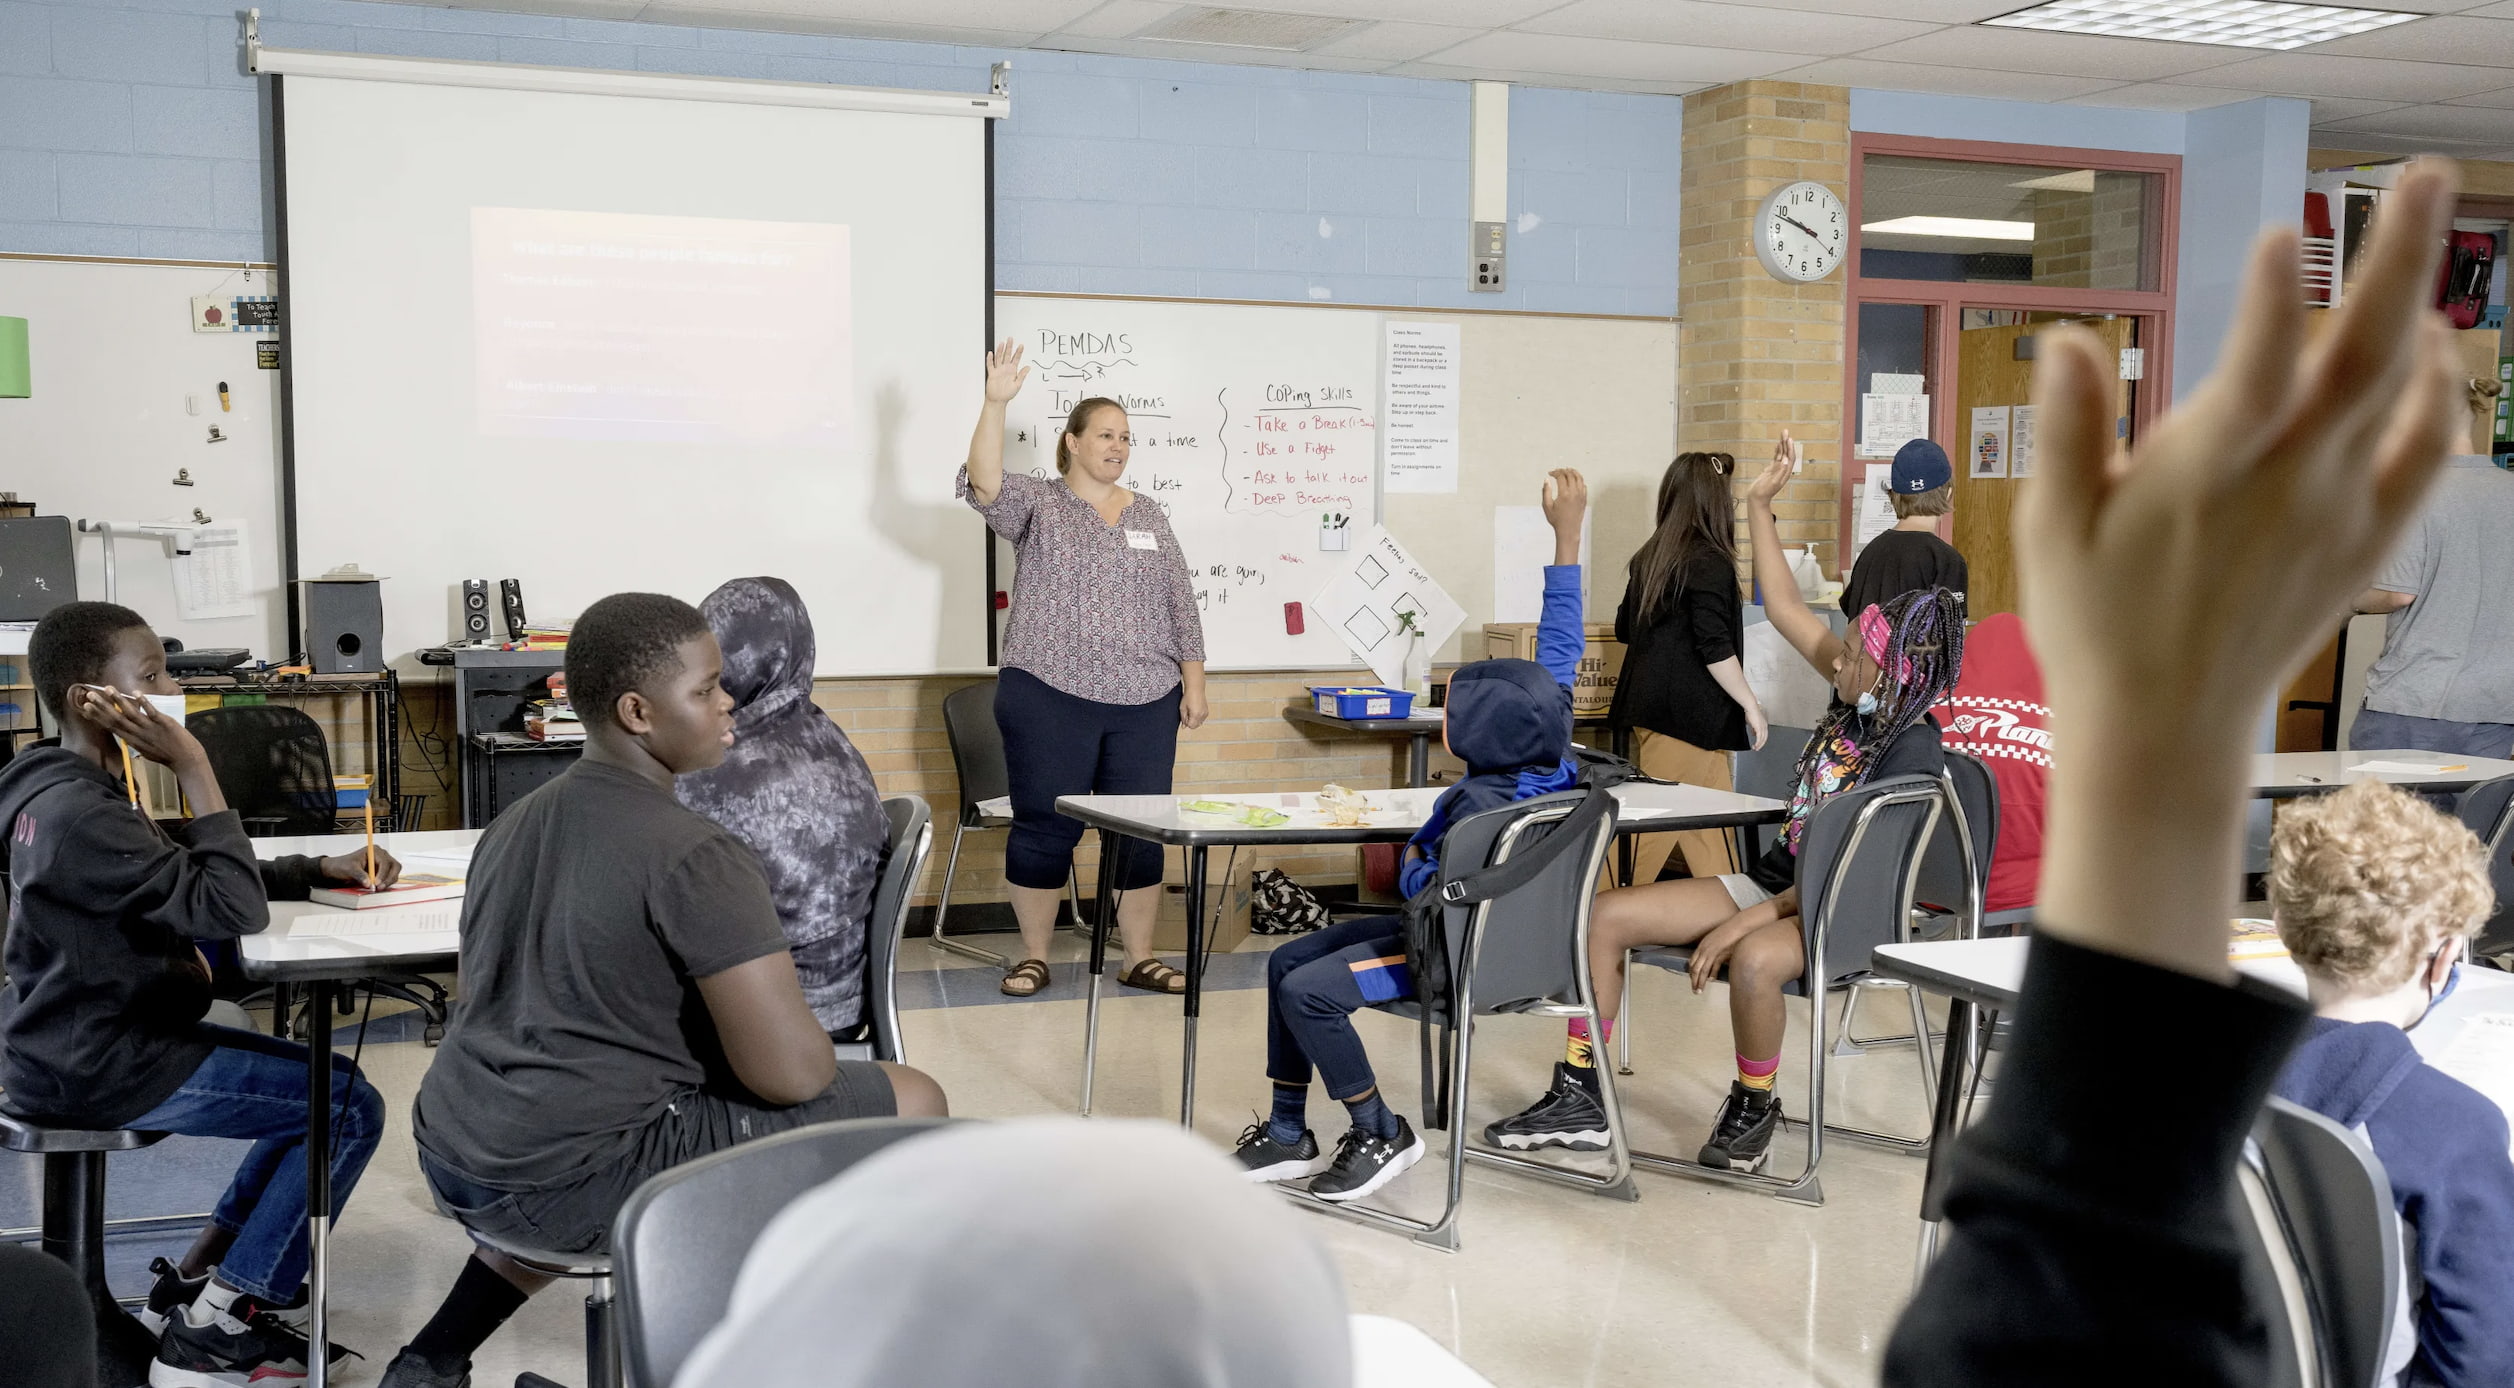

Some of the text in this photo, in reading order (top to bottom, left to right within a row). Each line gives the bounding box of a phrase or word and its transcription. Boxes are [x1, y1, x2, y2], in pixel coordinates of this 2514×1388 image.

[1791, 194, 1799, 205] 11
[1805, 191, 1814, 202] 12
[1779, 205, 1788, 217] 10
[1830, 211, 1837, 223] 2
[1775, 223, 1781, 234] 9
[1833, 229, 1839, 240] 3
[1778, 240, 1784, 251] 8
[1828, 246, 1834, 257] 4
[1788, 254, 1794, 265] 7
[1816, 257, 1822, 268] 5
[1801, 261, 1807, 272] 6
[253, 311, 273, 319] Touch
[1037, 328, 1133, 356] PEMDAS
[1118, 394, 1165, 411] Norms
[1254, 415, 1288, 432] Take
[1298, 421, 1306, 430] a
[1312, 415, 1345, 429] Break
[1149, 438, 1157, 447] a
[1166, 432, 1200, 447] time
[1288, 444, 1295, 453] a
[1305, 441, 1336, 461] Fidget
[1125, 473, 1182, 491] to best
[1254, 470, 1277, 484] Ask
[1286, 471, 1296, 483] to
[1305, 470, 1331, 484] talk
[1349, 475, 1368, 484] out
[1296, 491, 1352, 509] Breathing
[1210, 564, 1228, 579] are
[1218, 588, 1230, 604] it
[1573, 673, 1618, 687] Value
[1973, 708, 2055, 750] Plan
